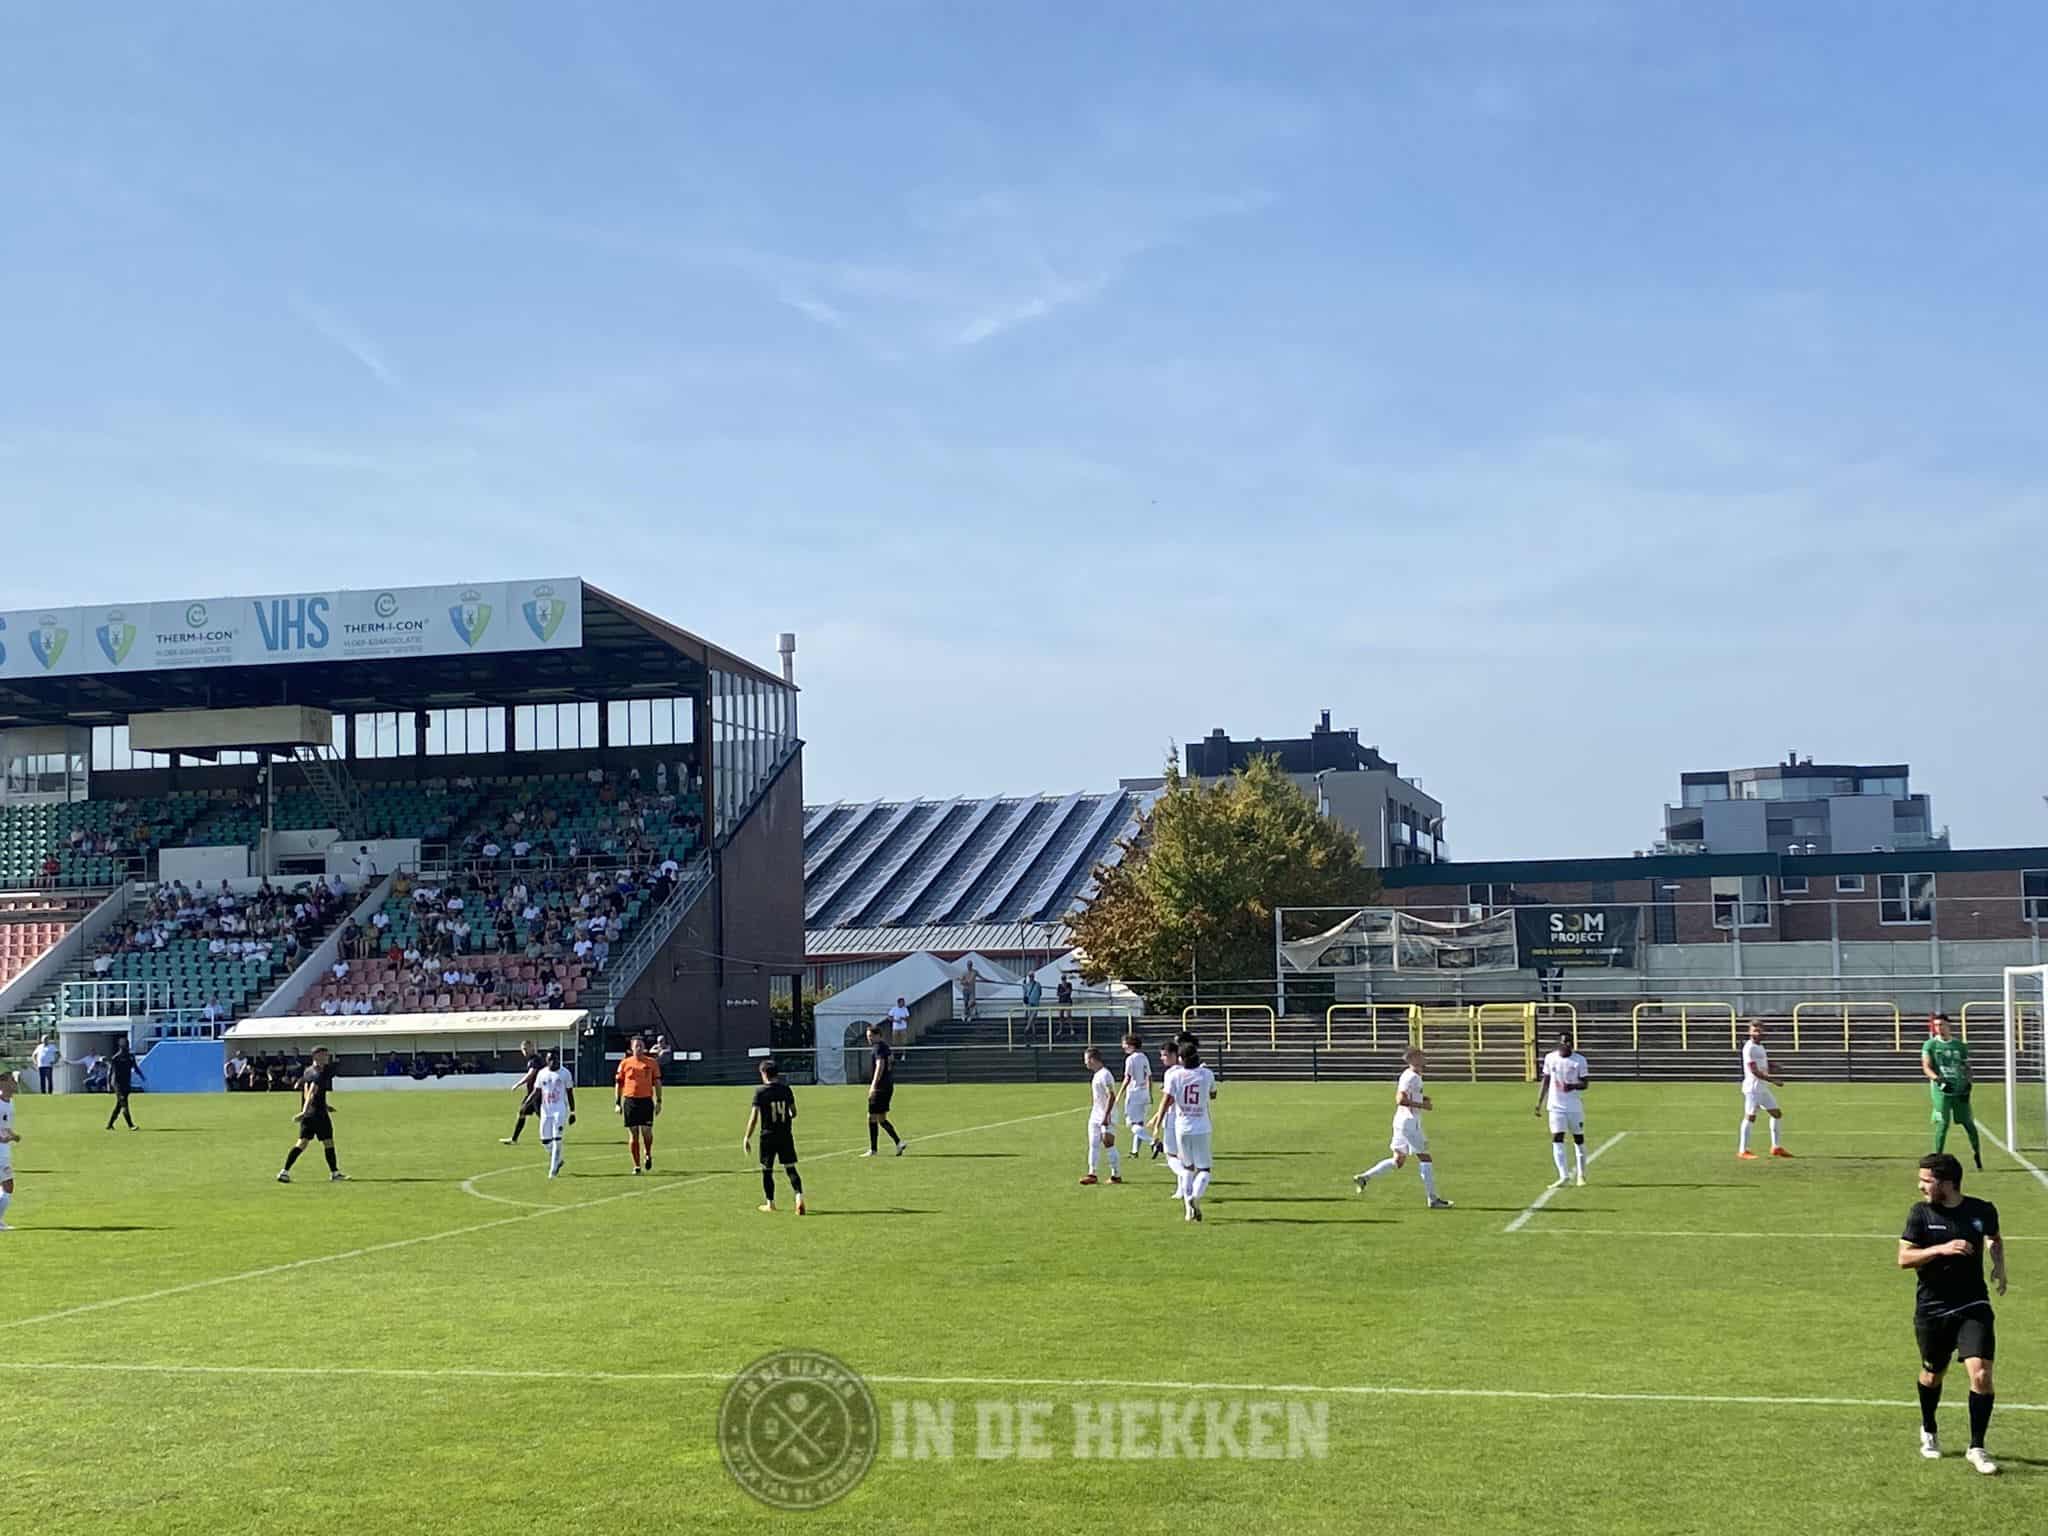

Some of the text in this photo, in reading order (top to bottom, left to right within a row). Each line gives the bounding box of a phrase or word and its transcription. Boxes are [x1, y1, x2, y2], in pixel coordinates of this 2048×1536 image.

[254, 597, 329, 651] VHS
[1550, 912, 1605, 932] SOM
[1551, 932, 1605, 944] PROJECT
[1183, 1084, 1200, 1105] 15
[770, 1100, 786, 1123] 14
